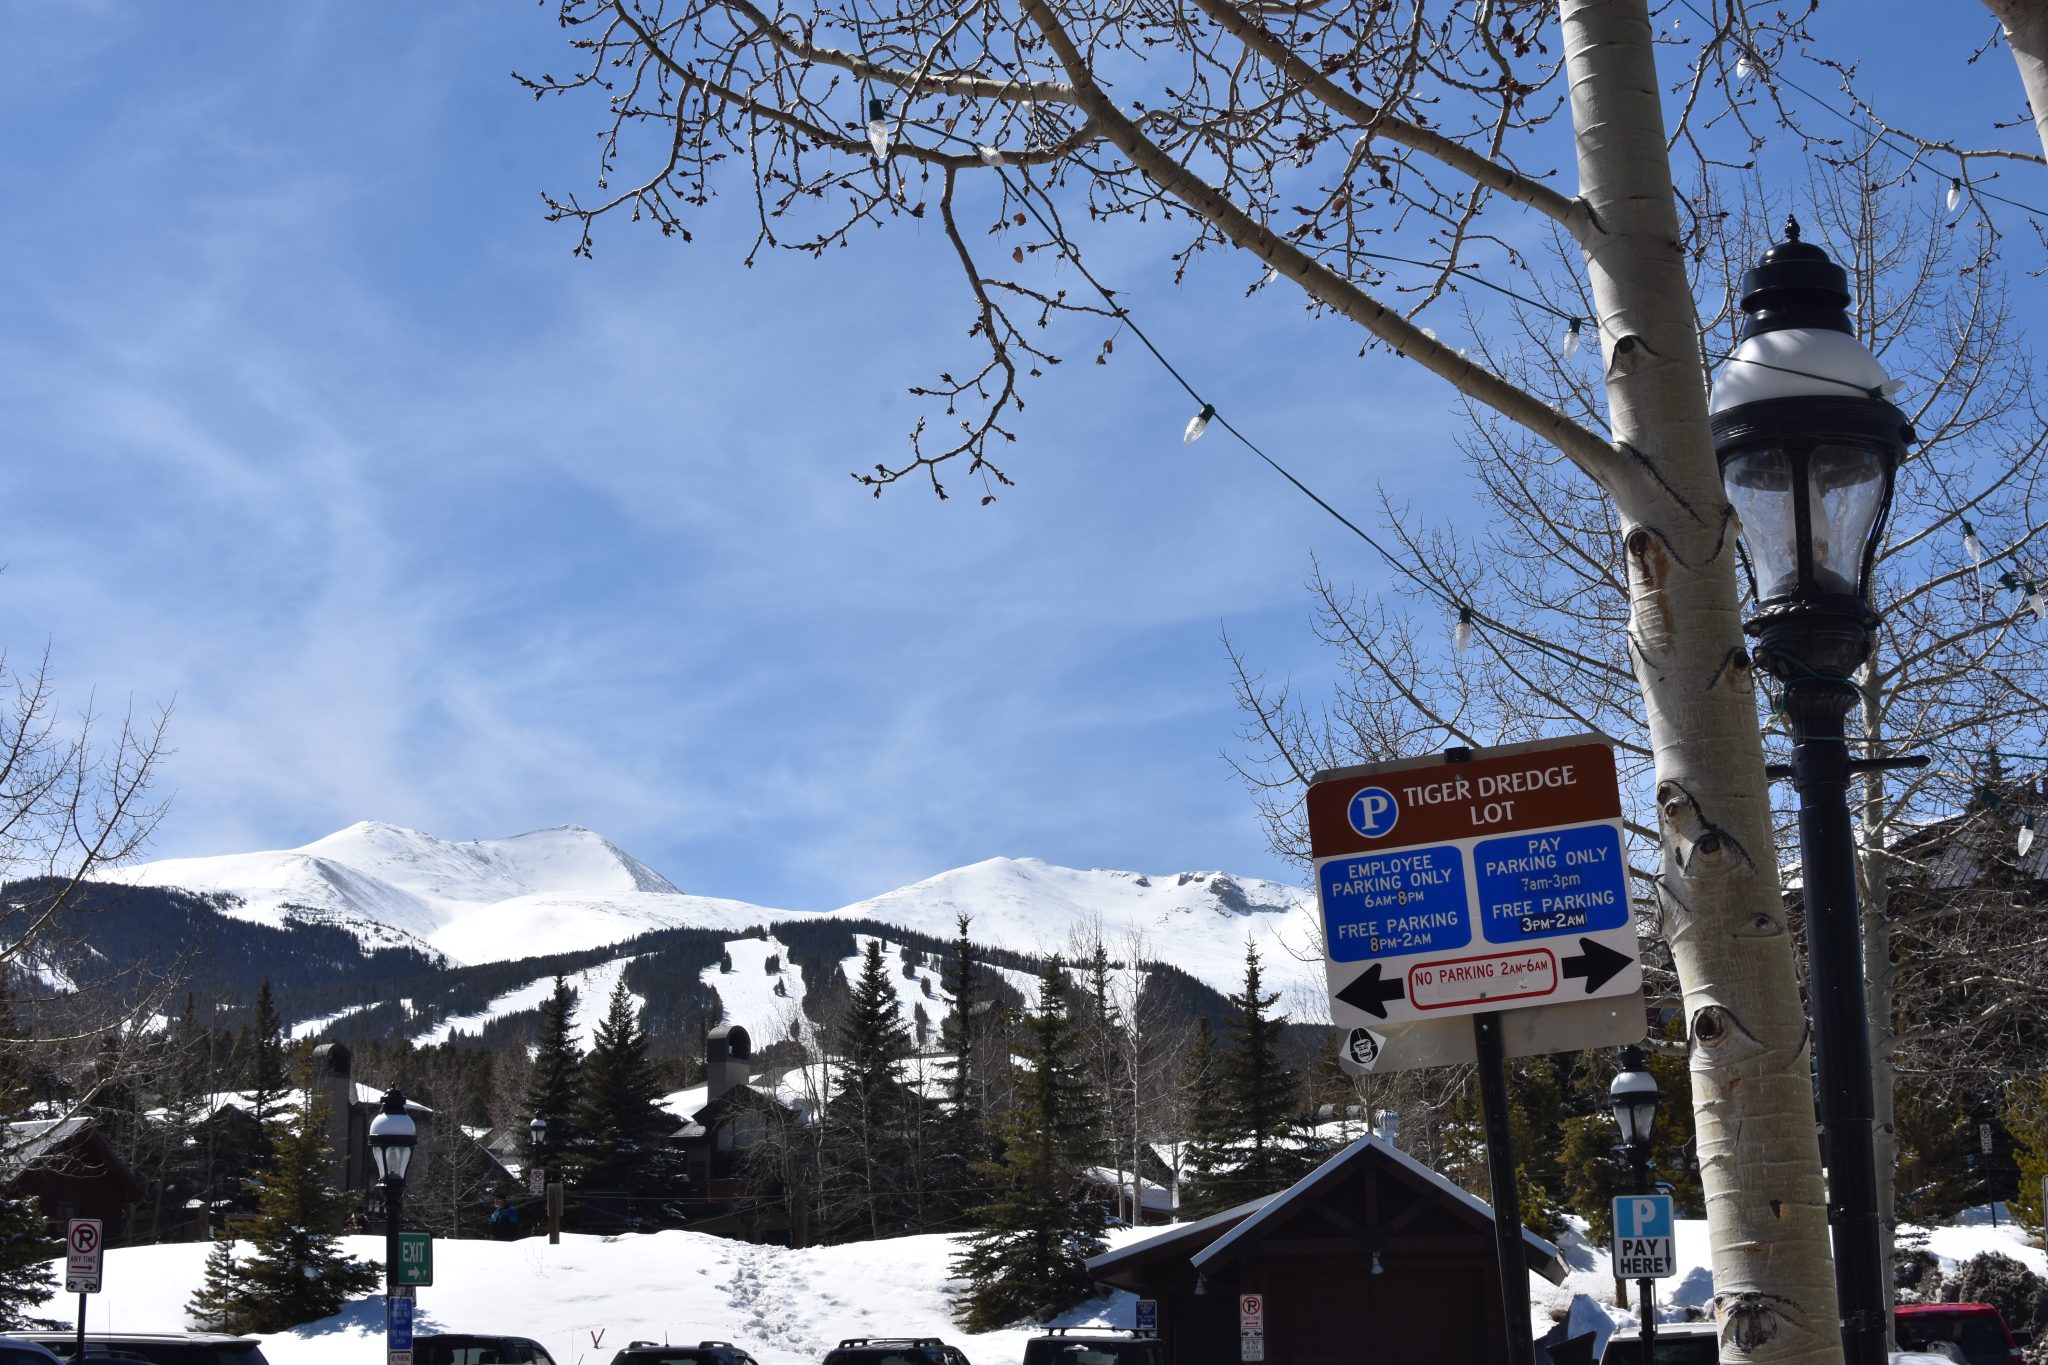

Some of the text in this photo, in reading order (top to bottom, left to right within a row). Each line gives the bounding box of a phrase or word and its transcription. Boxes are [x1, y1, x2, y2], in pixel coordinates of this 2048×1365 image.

[1403, 765, 1577, 807] TIGER DREDGE
[1359, 795, 1388, 830] P
[1470, 800, 1515, 826] LOT
[1528, 836, 1561, 854] PAY
[1348, 855, 1433, 879] EMPLOYEE
[1486, 846, 1608, 876] PARKING ONLY
[1332, 868, 1452, 897] PARKING ONLY
[1521, 874, 1581, 892] 7am-3pm
[1364, 891, 1424, 908] 6AM-8PM
[1492, 890, 1615, 920] FREE PARKING
[1338, 911, 1458, 940] FREE PARKING
[1522, 913, 1585, 932] 3PM-2AM
[1370, 933, 1432, 952] 8PM-2AM
[1415, 959, 1548, 986] NO PARKING 2AM-6AM
[1632, 1199, 1656, 1236] P
[70, 1255, 96, 1263] ANY TIME
[402, 1241, 425, 1263] EXIT
[1623, 1239, 1658, 1256] PAY
[1620, 1257, 1664, 1274] HERE
